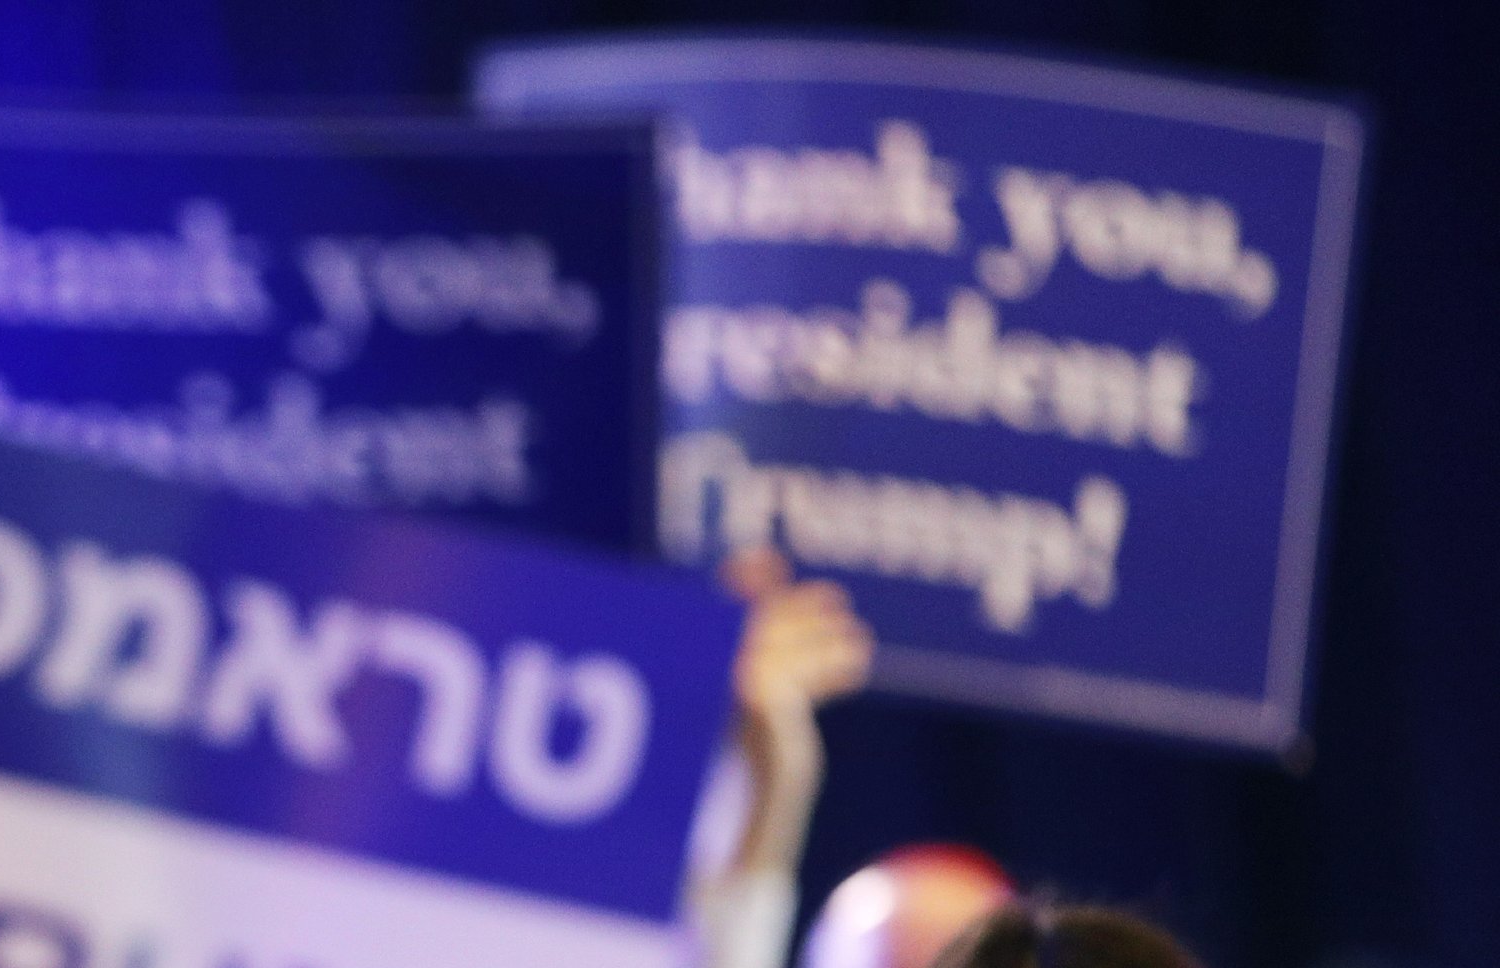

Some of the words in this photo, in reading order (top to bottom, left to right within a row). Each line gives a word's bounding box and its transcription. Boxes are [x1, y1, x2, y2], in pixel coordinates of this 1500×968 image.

[293, 232, 598, 371] you,
[659, 120, 959, 253] hank
[979, 165, 1277, 318] you,
[662, 279, 1196, 454] resident
